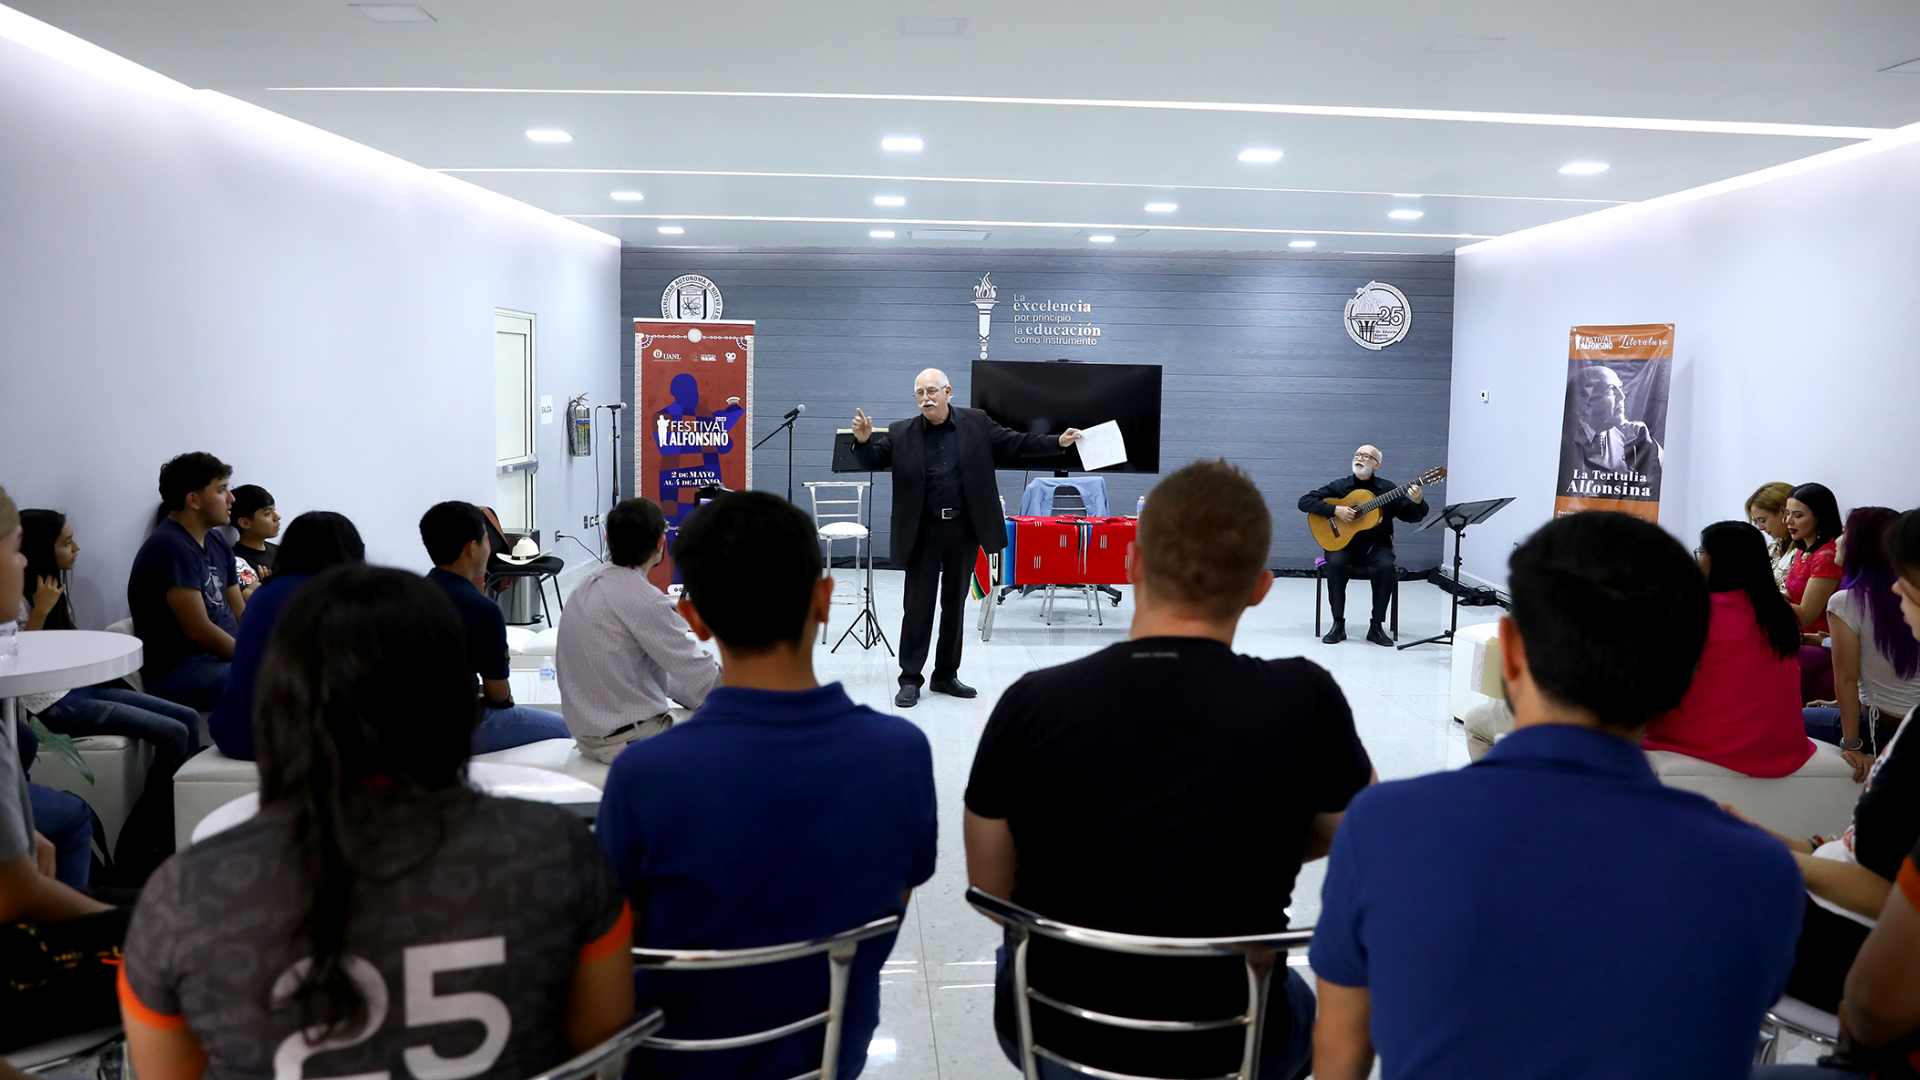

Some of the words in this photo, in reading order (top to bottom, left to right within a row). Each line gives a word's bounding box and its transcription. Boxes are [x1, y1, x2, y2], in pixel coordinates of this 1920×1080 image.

[1013, 299, 1091, 312] excelencia
[1014, 314, 1030, 323] por
[1032, 314, 1072, 323] principio
[1376, 306, 1404, 326] 25
[1014, 325, 1023, 335] la
[1025, 322, 1101, 336] educación
[1014, 336, 1041, 344] como
[1042, 336, 1097, 345] instrumento
[1618, 335, 1668, 349] Literatura
[670, 421, 727, 432] FESTIVAL
[669, 432, 729, 446] ALFONSINO
[1573, 469, 1588, 479] La
[1592, 470, 1647, 482] Tertulia
[1566, 480, 1650, 496] Alfonsina
[270, 936, 512, 1080] 25
